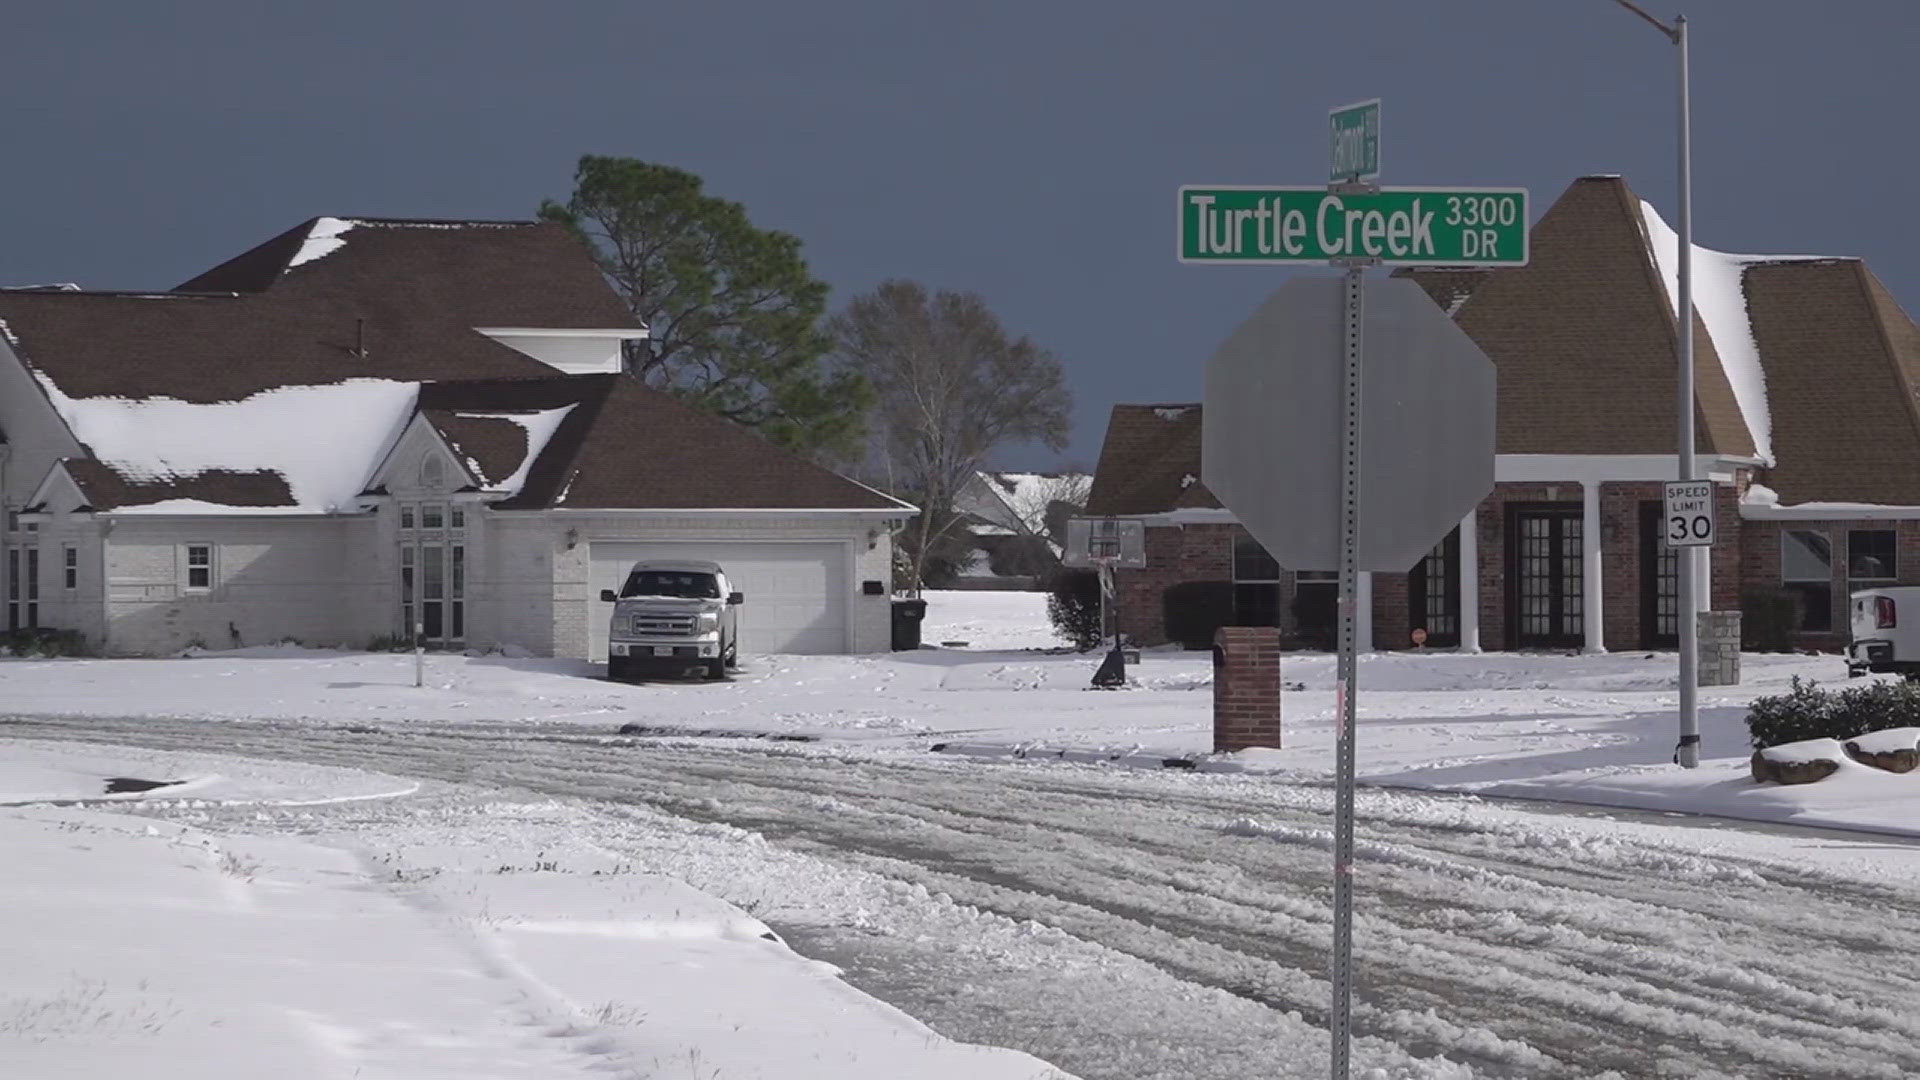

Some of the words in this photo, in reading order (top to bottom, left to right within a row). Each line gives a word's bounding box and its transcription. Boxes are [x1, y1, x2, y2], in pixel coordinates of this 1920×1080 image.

[1445, 196, 1517, 226] 3300
[1190, 195, 1307, 255] Turtle
[1316, 195, 1435, 255] Creek
[1462, 229, 1498, 258] DR
[1668, 487, 1709, 498] SPEED
[1672, 501, 1705, 512] LIMIT
[1670, 515, 1710, 539] 30
